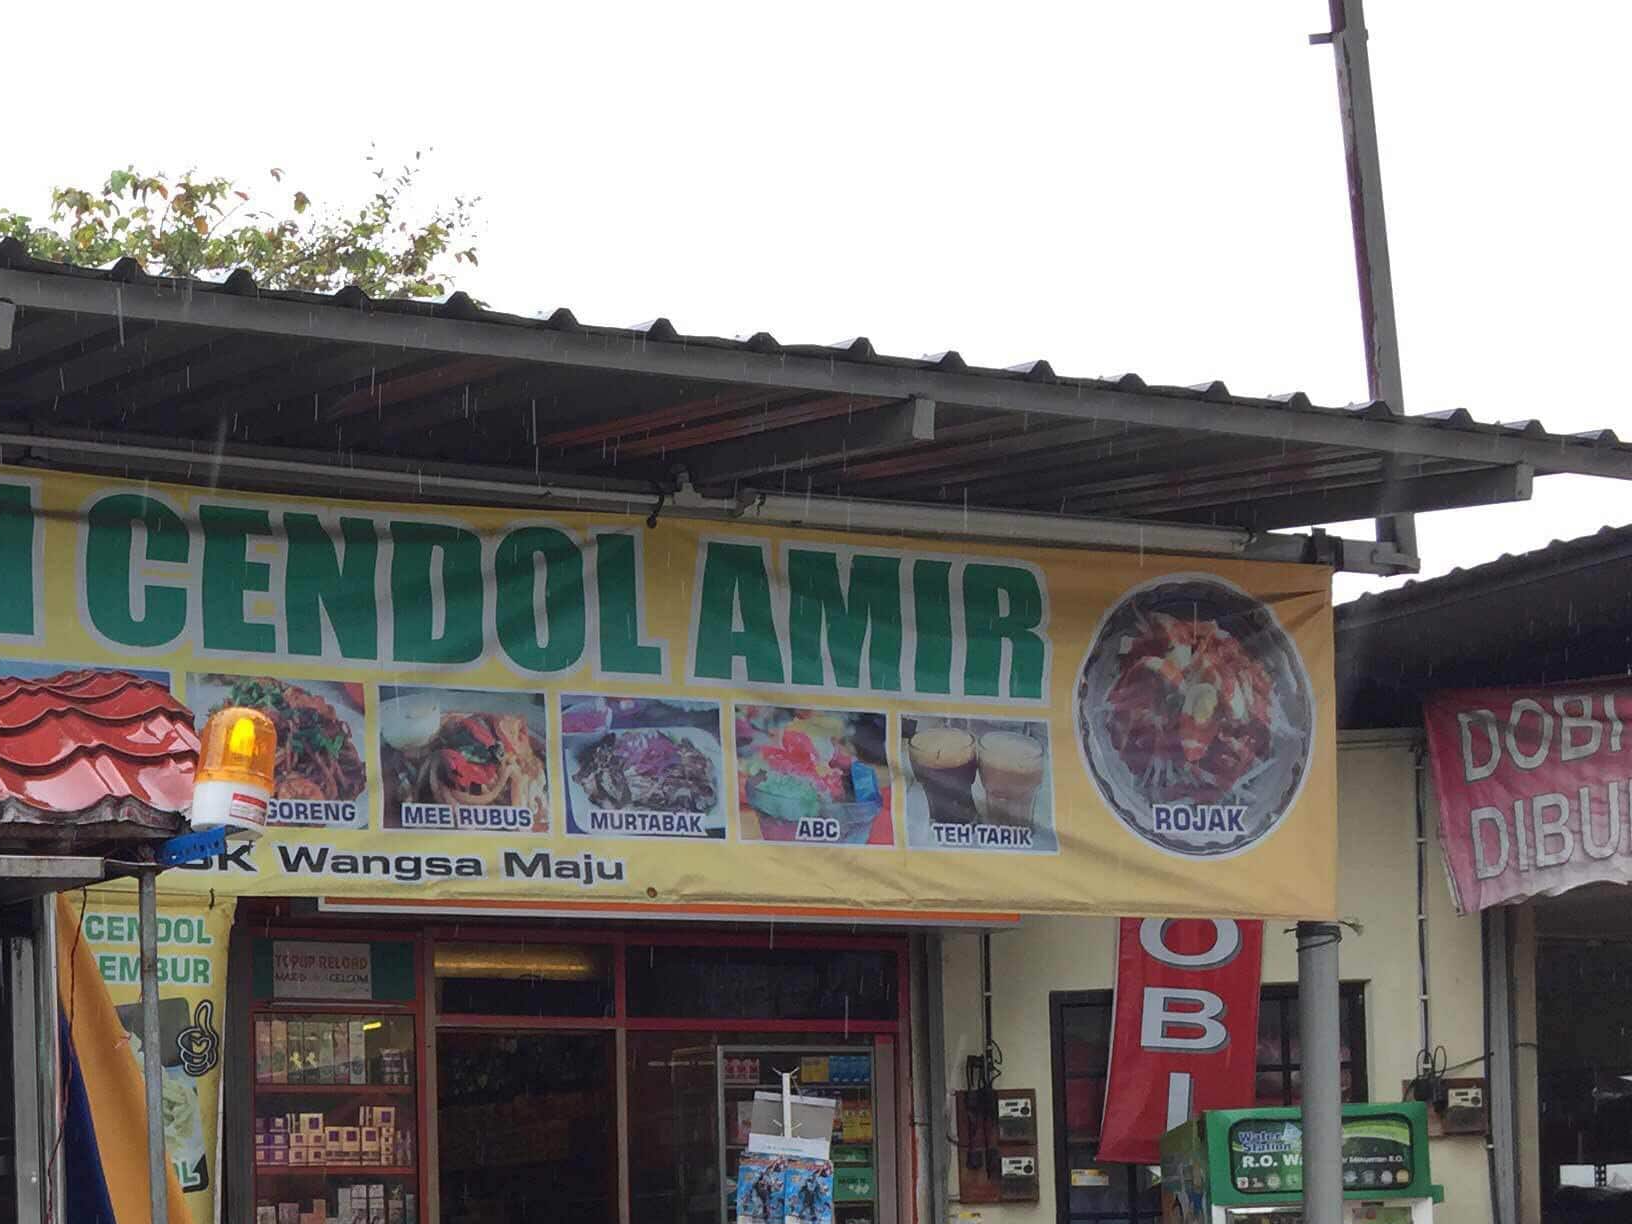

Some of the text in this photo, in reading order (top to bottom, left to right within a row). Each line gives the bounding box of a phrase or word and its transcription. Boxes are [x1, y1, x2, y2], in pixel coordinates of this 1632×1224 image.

[85, 493, 662, 678] CENDOL
[693, 538, 1044, 700] AMIR
[1457, 693, 1624, 784] DOBI
[404, 805, 451, 828] MEE
[590, 811, 703, 834] MURTABAK
[798, 819, 838, 840] ABC
[1154, 806, 1245, 834] ROJAK
[933, 823, 1032, 848] TEH TARIK
[278, 843, 484, 881] Wangsa
[503, 850, 625, 883] Maju
[84, 914, 212, 945] CENDOL
[97, 955, 211, 984] EMBUR
[1138, 916, 1244, 1131] OBI
[1241, 1154, 1279, 1169] R.O.
